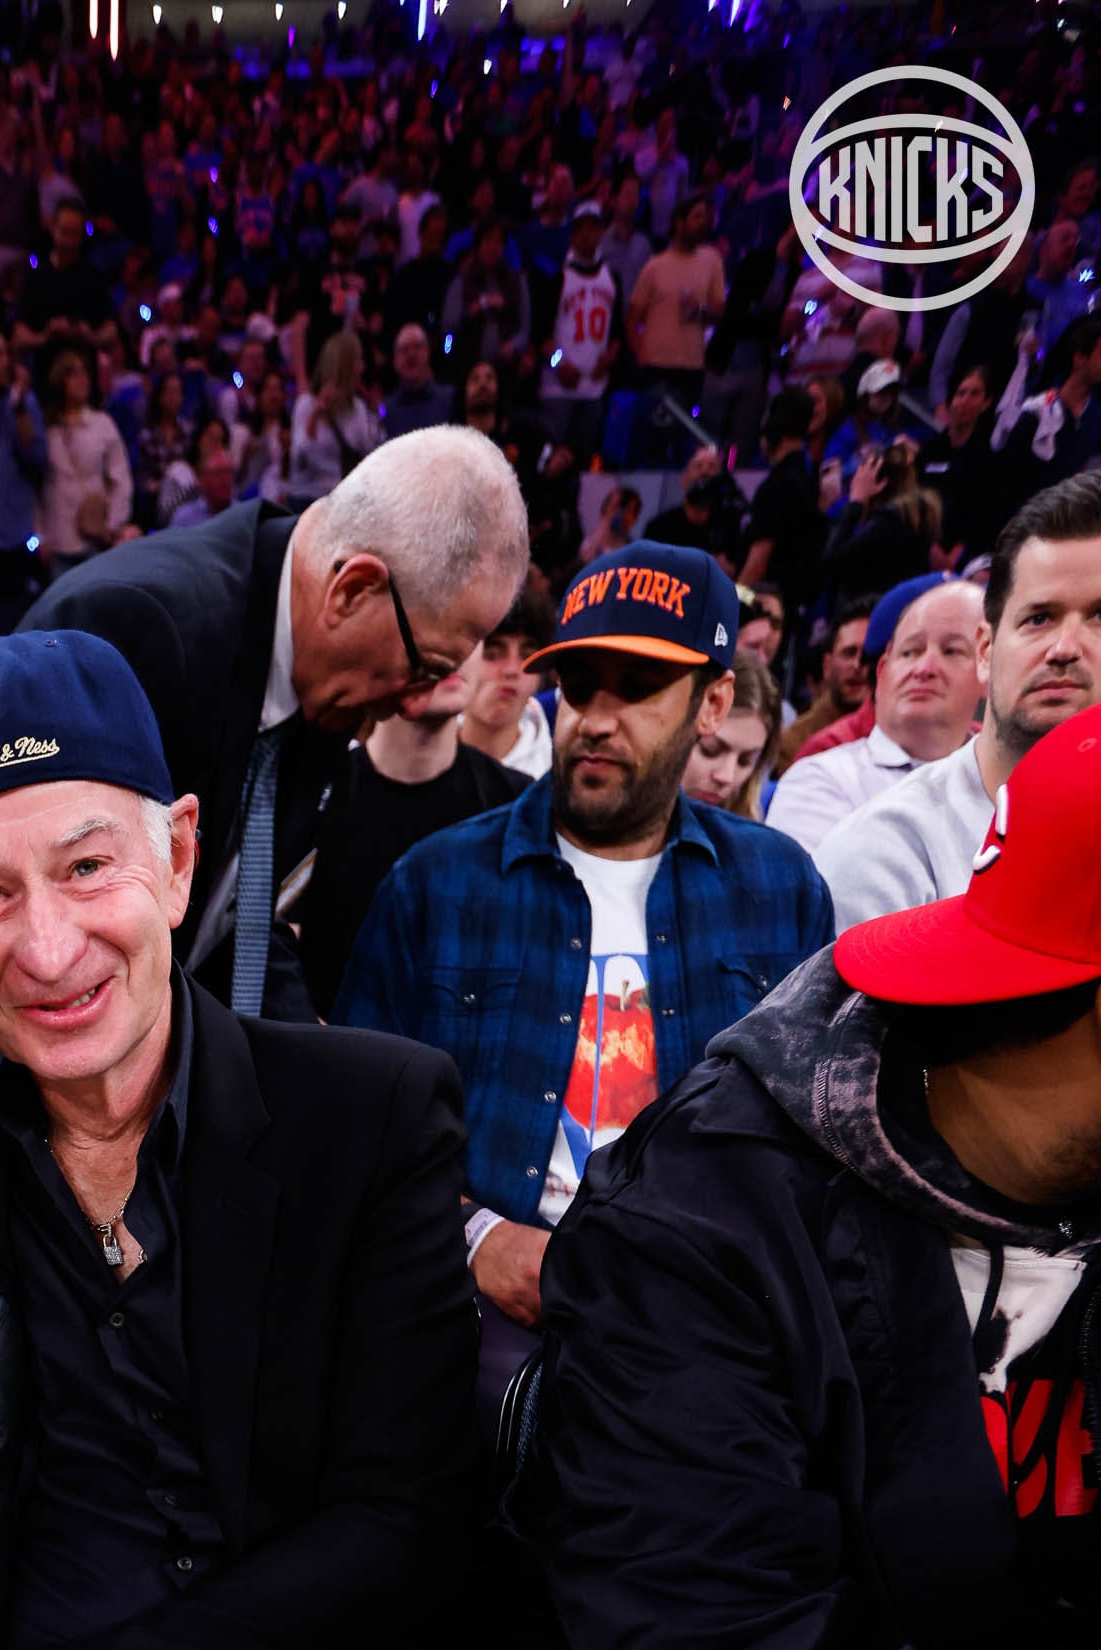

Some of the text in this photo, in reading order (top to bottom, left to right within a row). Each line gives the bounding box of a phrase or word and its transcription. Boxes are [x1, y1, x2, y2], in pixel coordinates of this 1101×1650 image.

[574, 307, 607, 342] 10
[560, 566, 692, 626] NEW YORK
[0, 743, 16, 762] &
[14, 736, 60, 758] Ness
